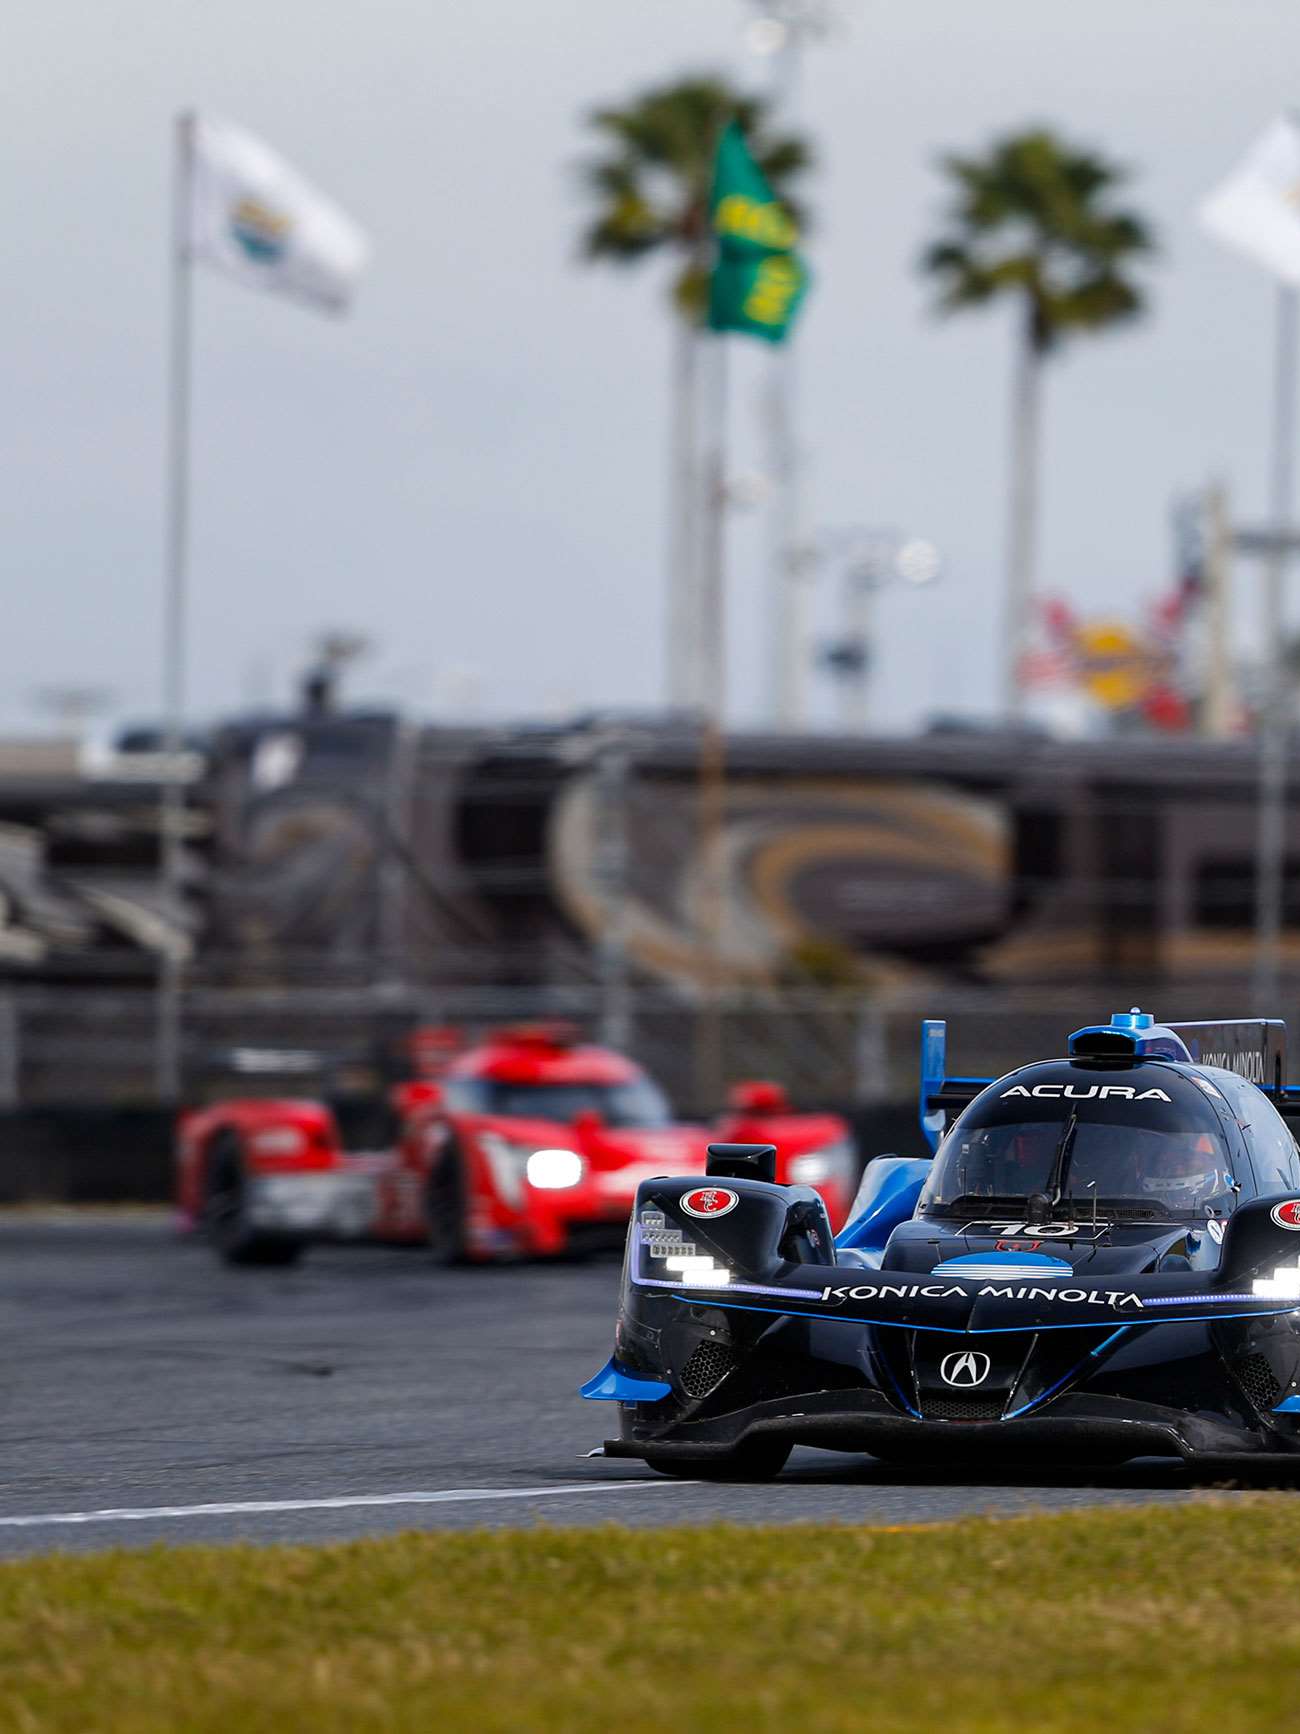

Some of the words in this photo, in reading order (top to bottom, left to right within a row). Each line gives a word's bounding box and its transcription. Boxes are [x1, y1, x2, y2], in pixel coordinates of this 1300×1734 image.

[1000, 1084, 1172, 1102] ACURA
[990, 1223, 1079, 1237] 10
[821, 1285, 969, 1300] KONICA
[978, 1285, 1144, 1307] MINOLTA
